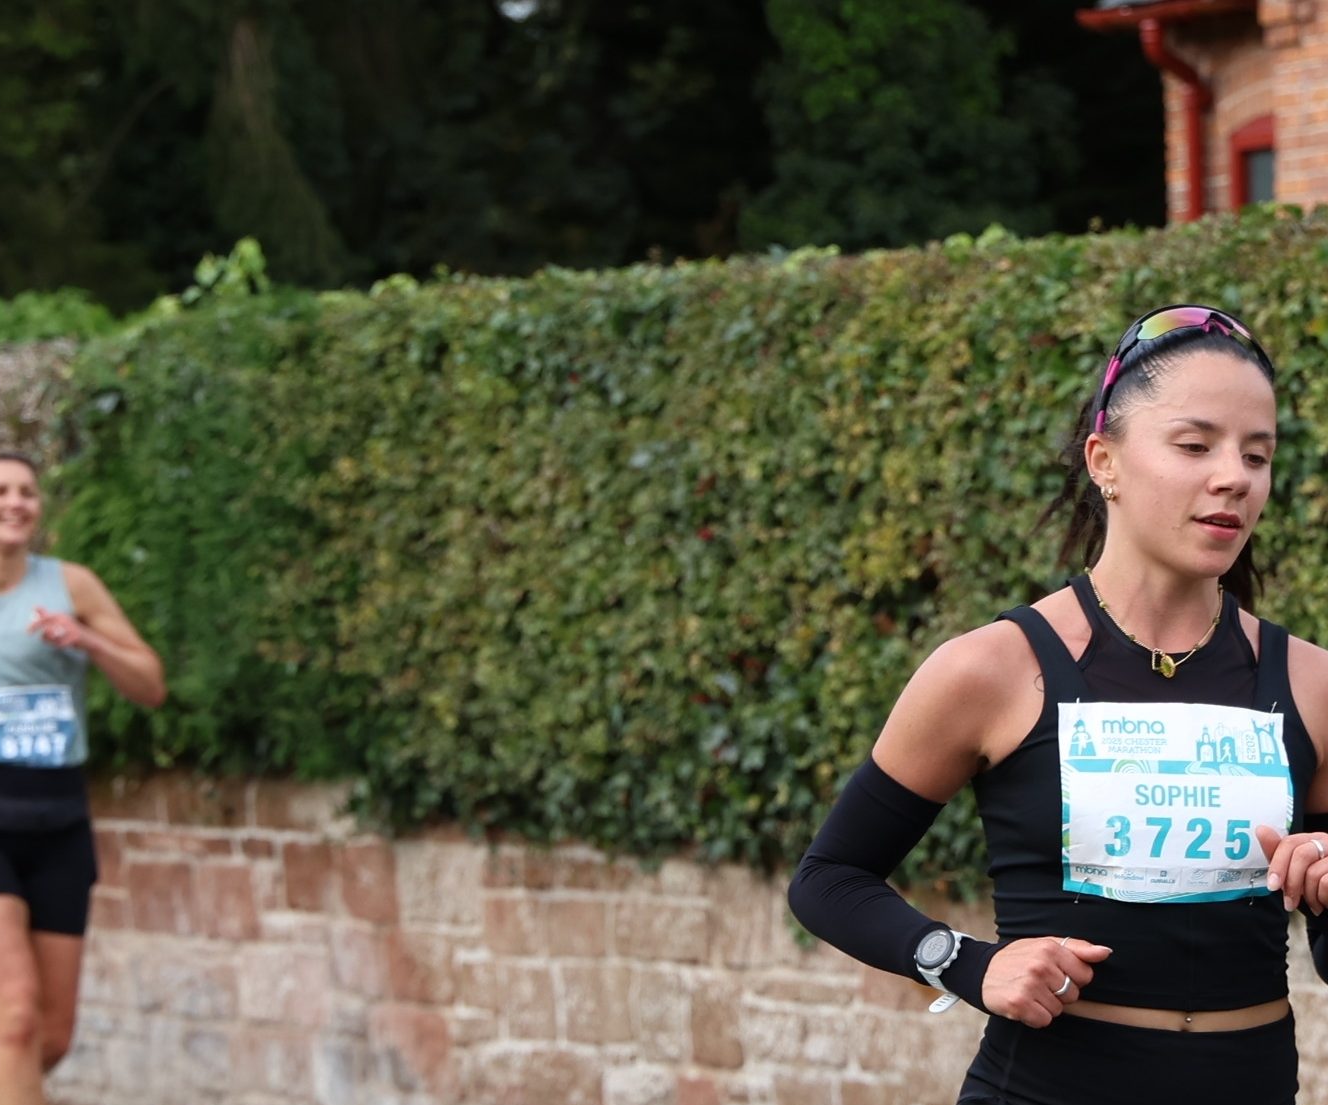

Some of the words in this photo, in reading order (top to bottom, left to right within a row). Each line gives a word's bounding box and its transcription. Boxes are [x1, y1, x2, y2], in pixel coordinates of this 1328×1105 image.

[1101, 716, 1165, 735] mbna
[1107, 745, 1161, 754] MARATHON
[1125, 737, 1168, 746] CHESTER
[1135, 783, 1221, 808] SOPHIE
[1104, 815, 1251, 860] 3725
[1075, 864, 1108, 877] mbna
